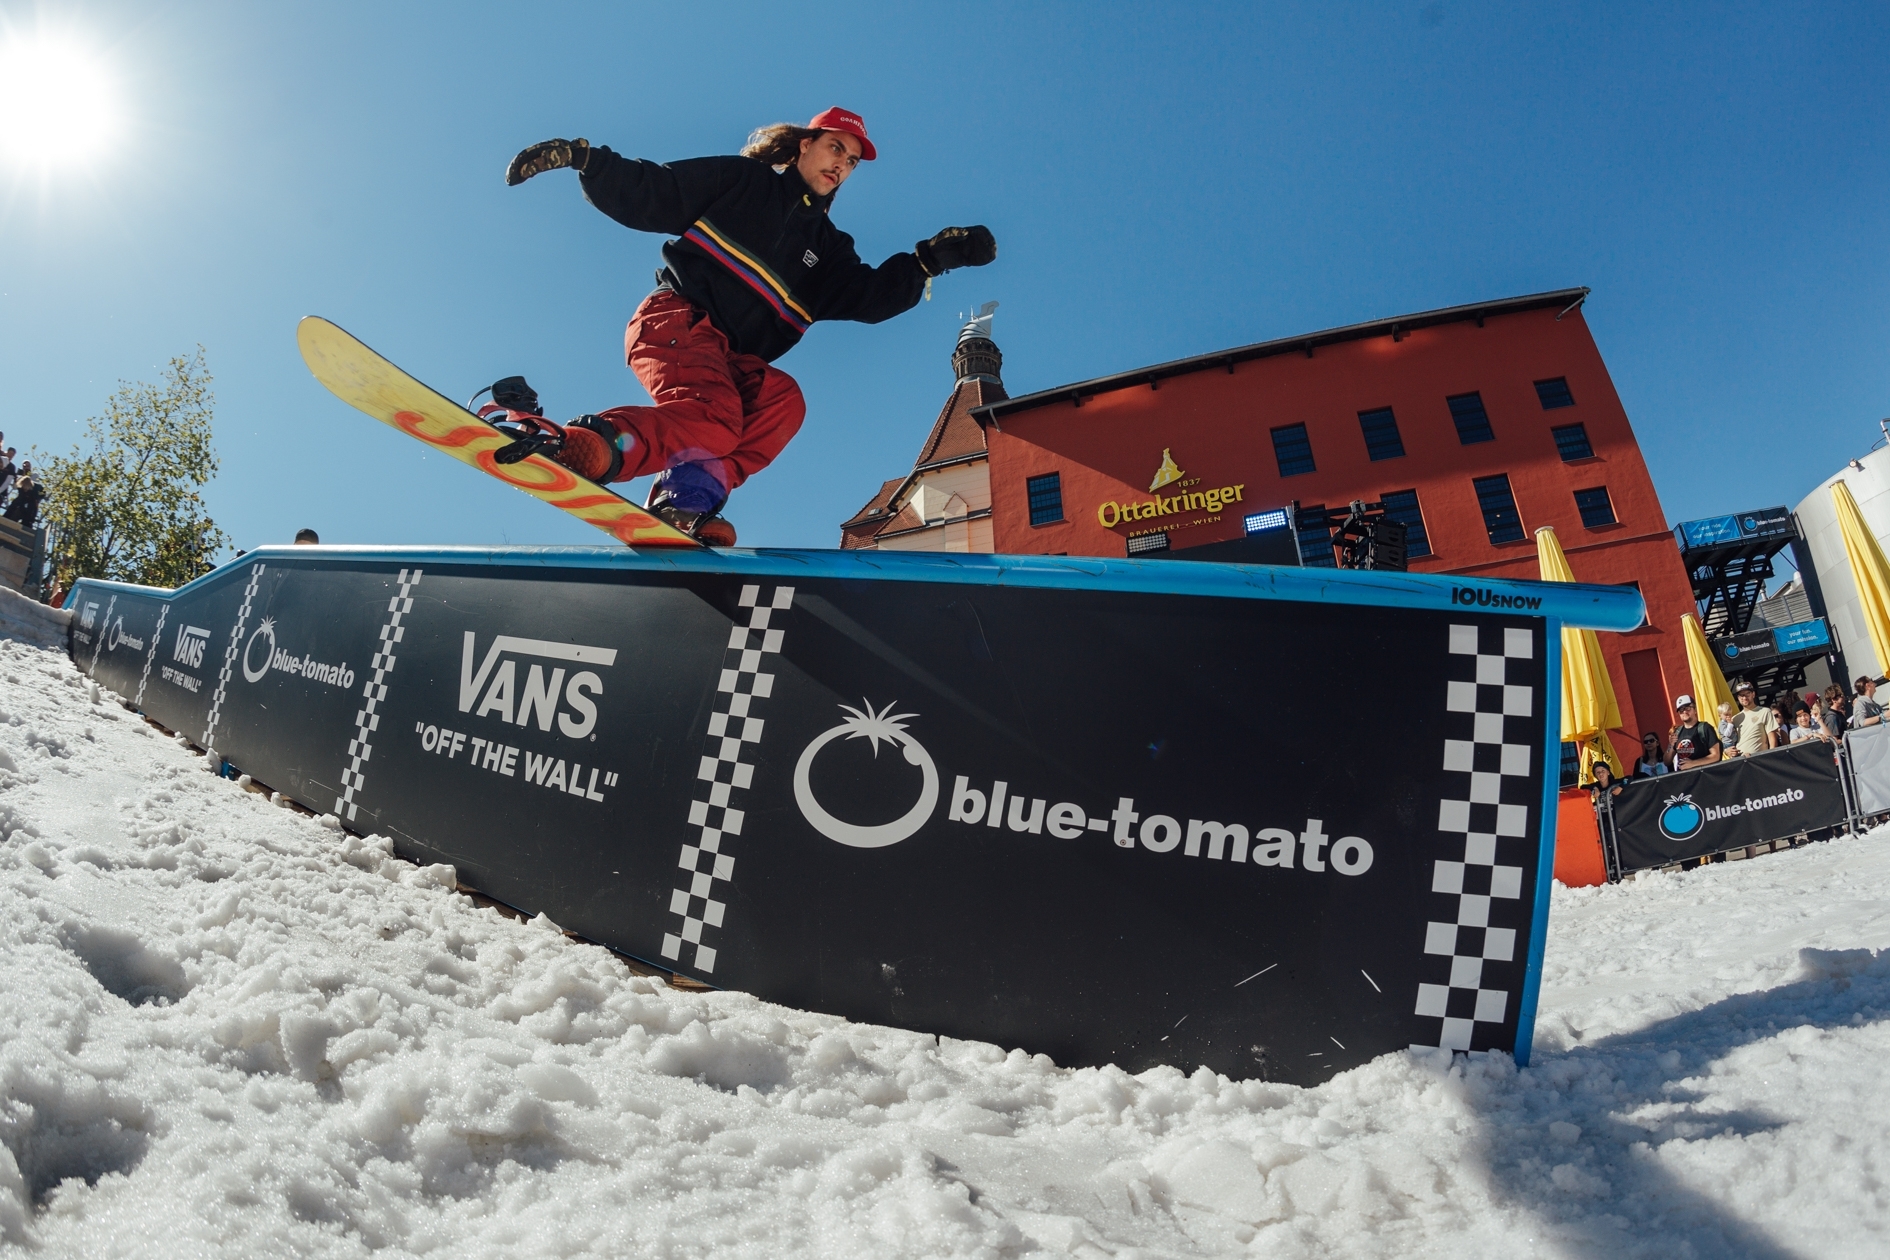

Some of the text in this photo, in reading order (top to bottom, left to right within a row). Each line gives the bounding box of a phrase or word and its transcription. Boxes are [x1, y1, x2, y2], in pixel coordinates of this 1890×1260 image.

[1176, 478, 1201, 488] 1837
[1097, 484, 1245, 528] Ottakringer
[1129, 515, 1222, 538] BRAUEREI WIEN
[173, 623, 211, 669] VANS
[172, 670, 185, 686] THE
[271, 648, 355, 689] blue-tomato
[458, 631, 618, 739] VANS
[471, 737, 520, 777] THE
[1705, 788, 1804, 822] blue-tomato
[948, 775, 1374, 876] blue-tomato
